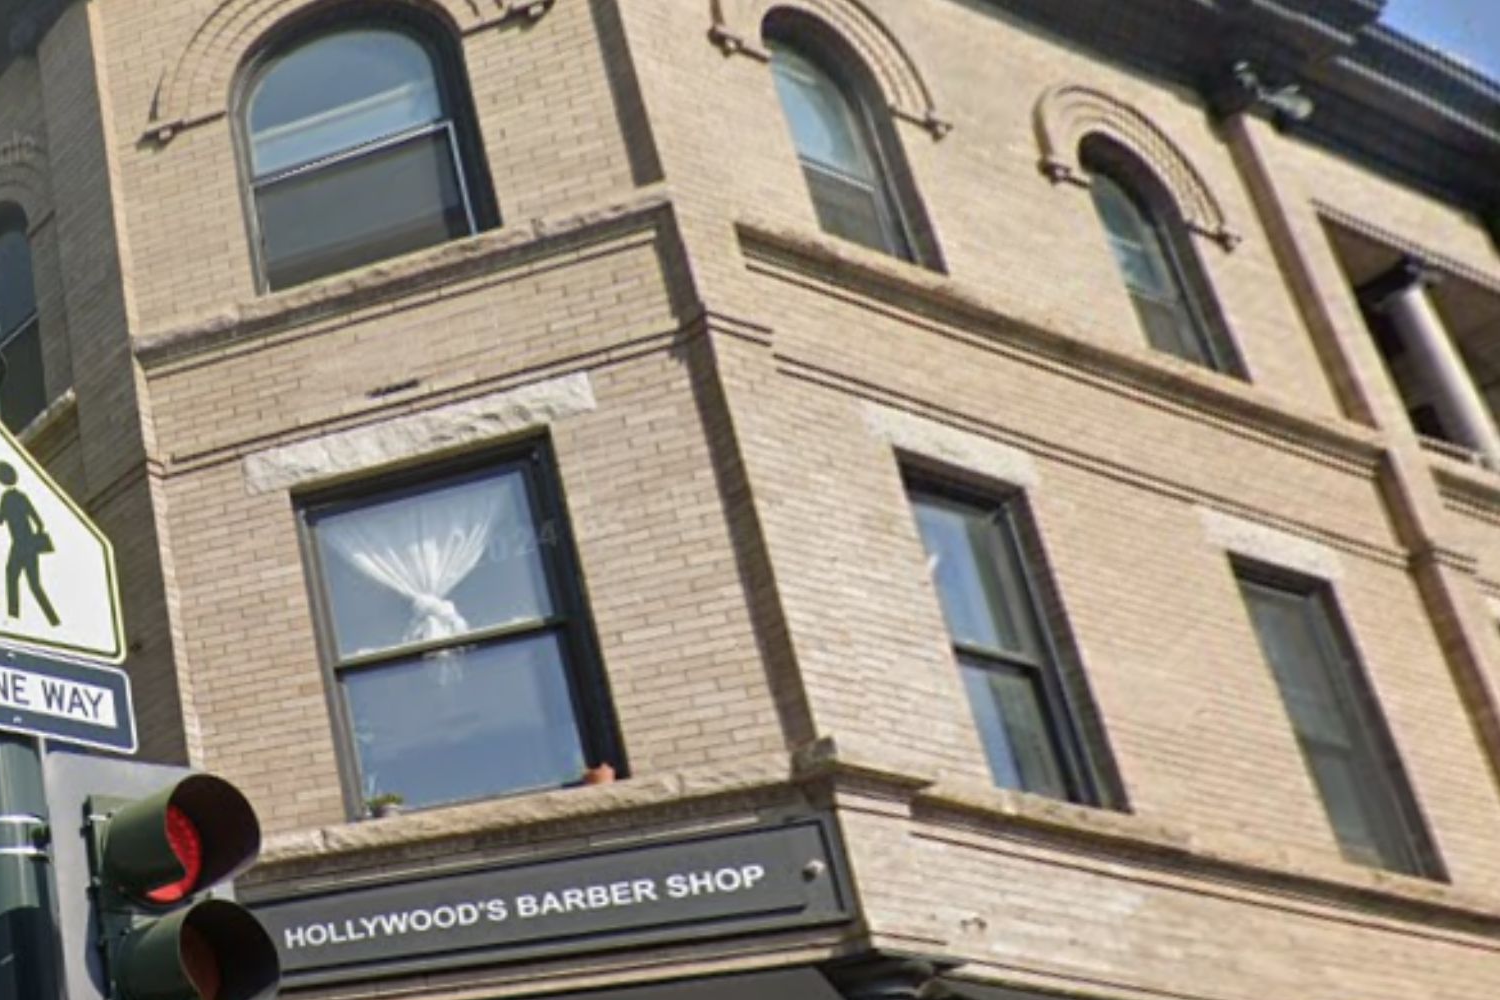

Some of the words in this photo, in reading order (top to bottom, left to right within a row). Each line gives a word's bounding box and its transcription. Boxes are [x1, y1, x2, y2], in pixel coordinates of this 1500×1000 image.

[42, 680, 104, 718] WAY
[284, 900, 508, 949] HOLLYWOOD'S
[516, 877, 657, 919] BARBER
[667, 864, 766, 899] SHOP
